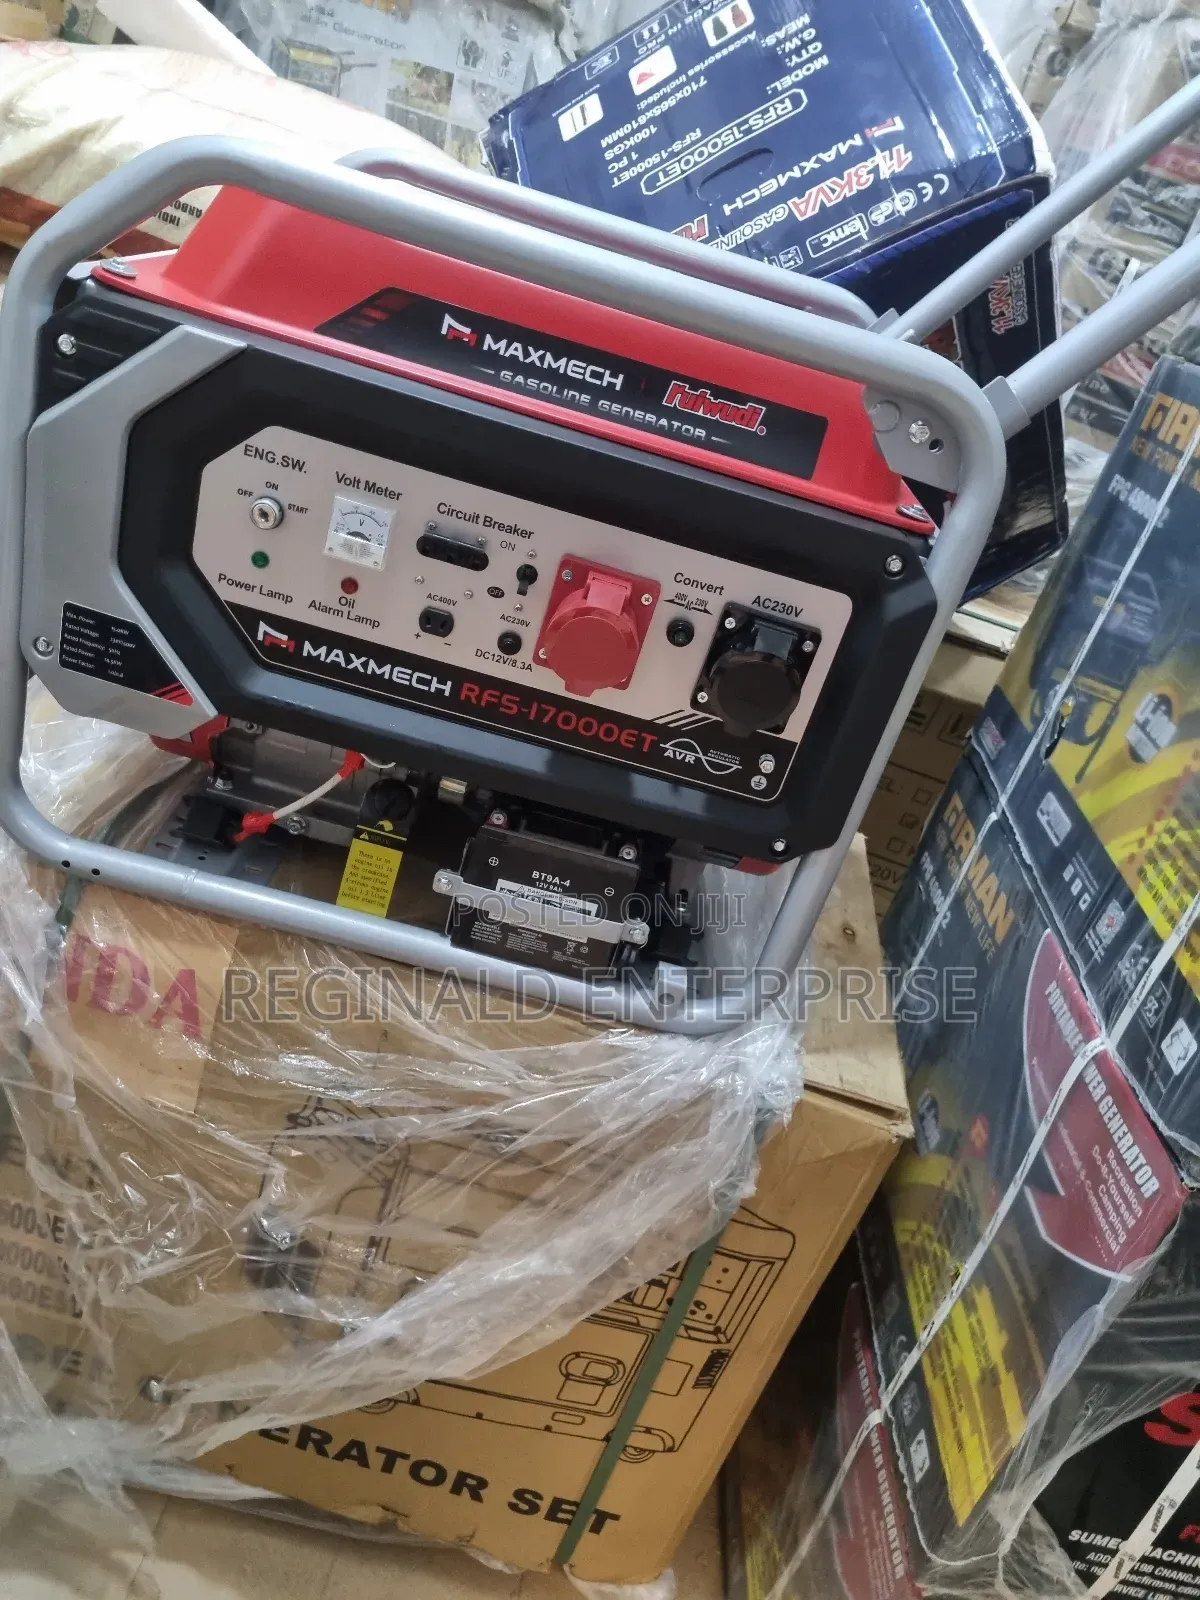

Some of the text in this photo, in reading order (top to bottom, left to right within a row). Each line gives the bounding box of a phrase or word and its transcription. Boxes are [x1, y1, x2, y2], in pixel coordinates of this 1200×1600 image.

[761, 13, 812, 47] MEAS:
[777, 28, 817, 54] G.W.:
[687, 30, 757, 76] Accessories
[785, 41, 823, 67] QTY:
[766, 55, 831, 94] MODEL:
[600, 75, 708, 149] 710x565x610MM
[604, 124, 658, 161] 100KGS
[656, 98, 793, 187] RFS-15000ET
[607, 157, 629, 174] PC
[612, 127, 702, 188] RFS-15000ET
[723, 133, 863, 216] MAXMECH
[152, 210, 181, 227] INDI
[170, 199, 203, 218] ARBO
[483, 333, 624, 391] MAXMECH
[500, 370, 707, 441] GASOLINE GENERATOR
[243, 443, 308, 474] ENG.SW.
[237, 487, 254, 498] OFF
[265, 481, 279, 491] ON
[335, 470, 403, 501] Volt Meter
[287, 503, 309, 515] START
[436, 502, 535, 540] Circuit Breaker
[500, 540, 517, 551] ON
[217, 573, 294, 605] Power Lamp
[488, 587, 503, 597] OFF
[673, 572, 725, 597] Convert
[338, 596, 356, 609] Oil
[426, 592, 458, 608] AC400V
[751, 594, 804, 619] AC230V
[308, 599, 381, 629] Alarm Lamp
[500, 613, 531, 629] AC230V
[475, 648, 534, 672] DC12V/8.3A
[302, 640, 658, 753] MAXMECH RFS-17000ET
[663, 748, 697, 765] AVR
[531, 870, 571, 887] BT9A-4
[535, 881, 548, 889] 12V
[1098, 1090, 1161, 1199] GENERATOR
[1097, 1183, 1127, 1246] Camping
